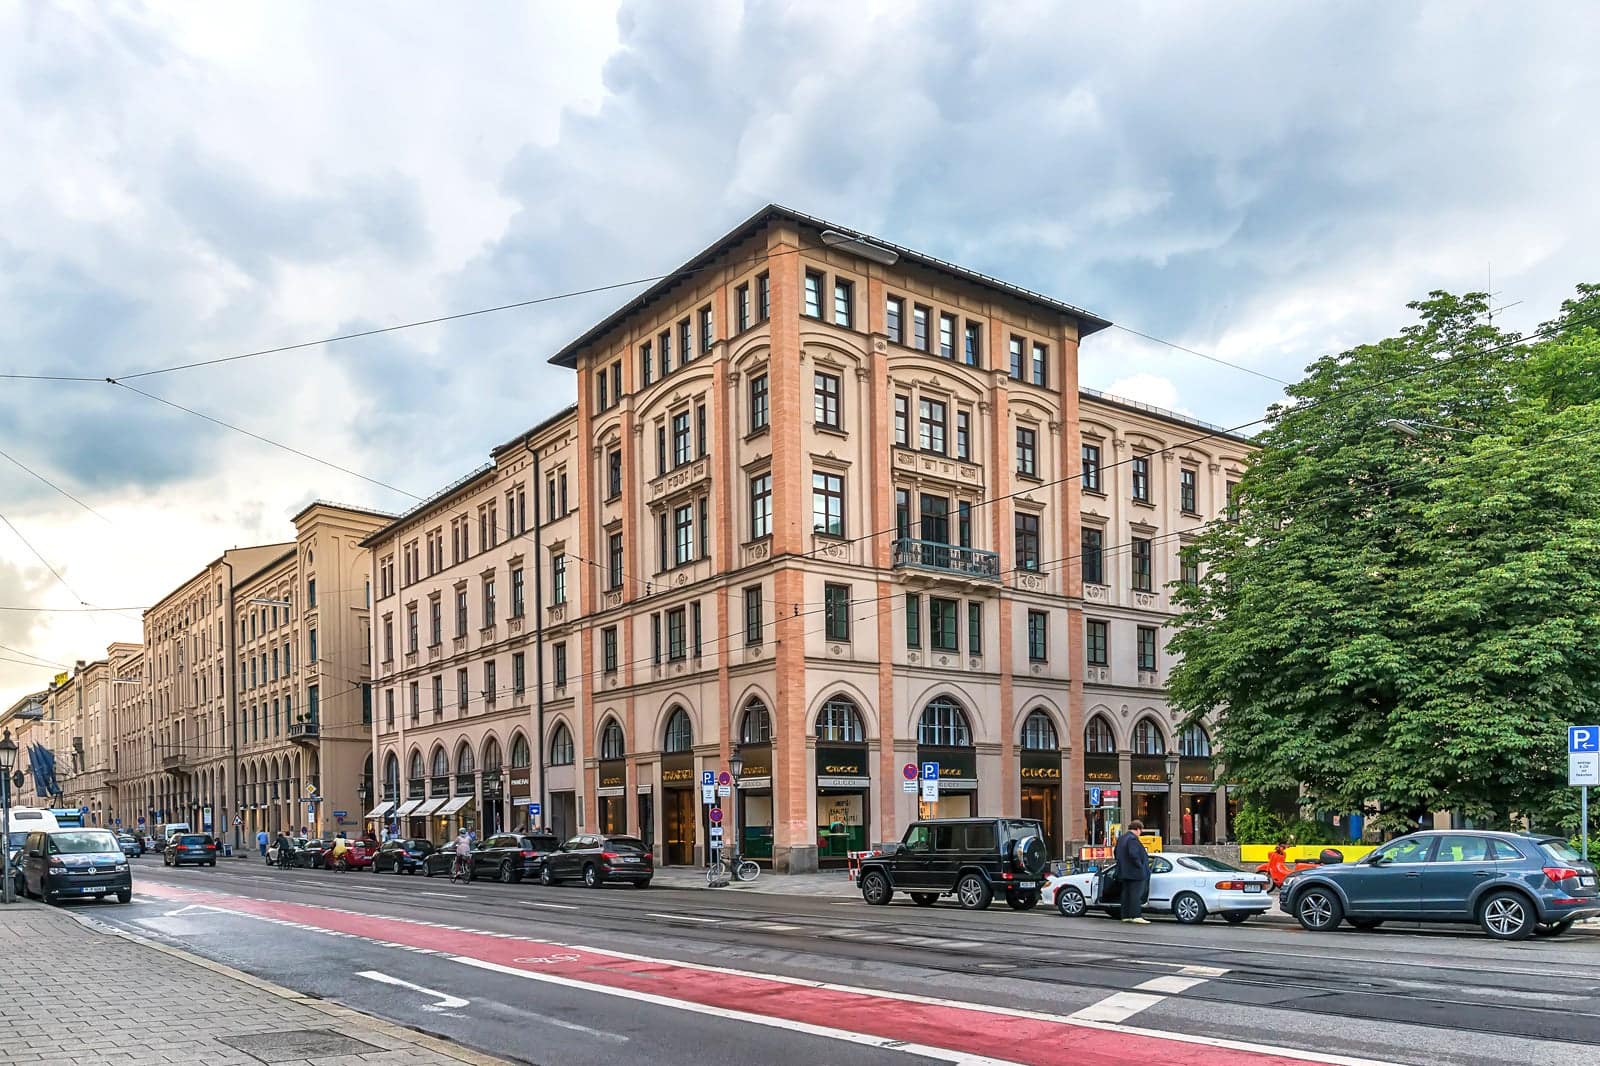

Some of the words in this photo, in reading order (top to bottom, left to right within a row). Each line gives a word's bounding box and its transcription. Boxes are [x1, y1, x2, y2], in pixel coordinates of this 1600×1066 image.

[1574, 729, 1591, 749] P
[825, 765, 859, 773] GUCCI
[925, 765, 934, 778] P
[1021, 767, 1060, 777] GUCCI
[704, 772, 712, 784] P
